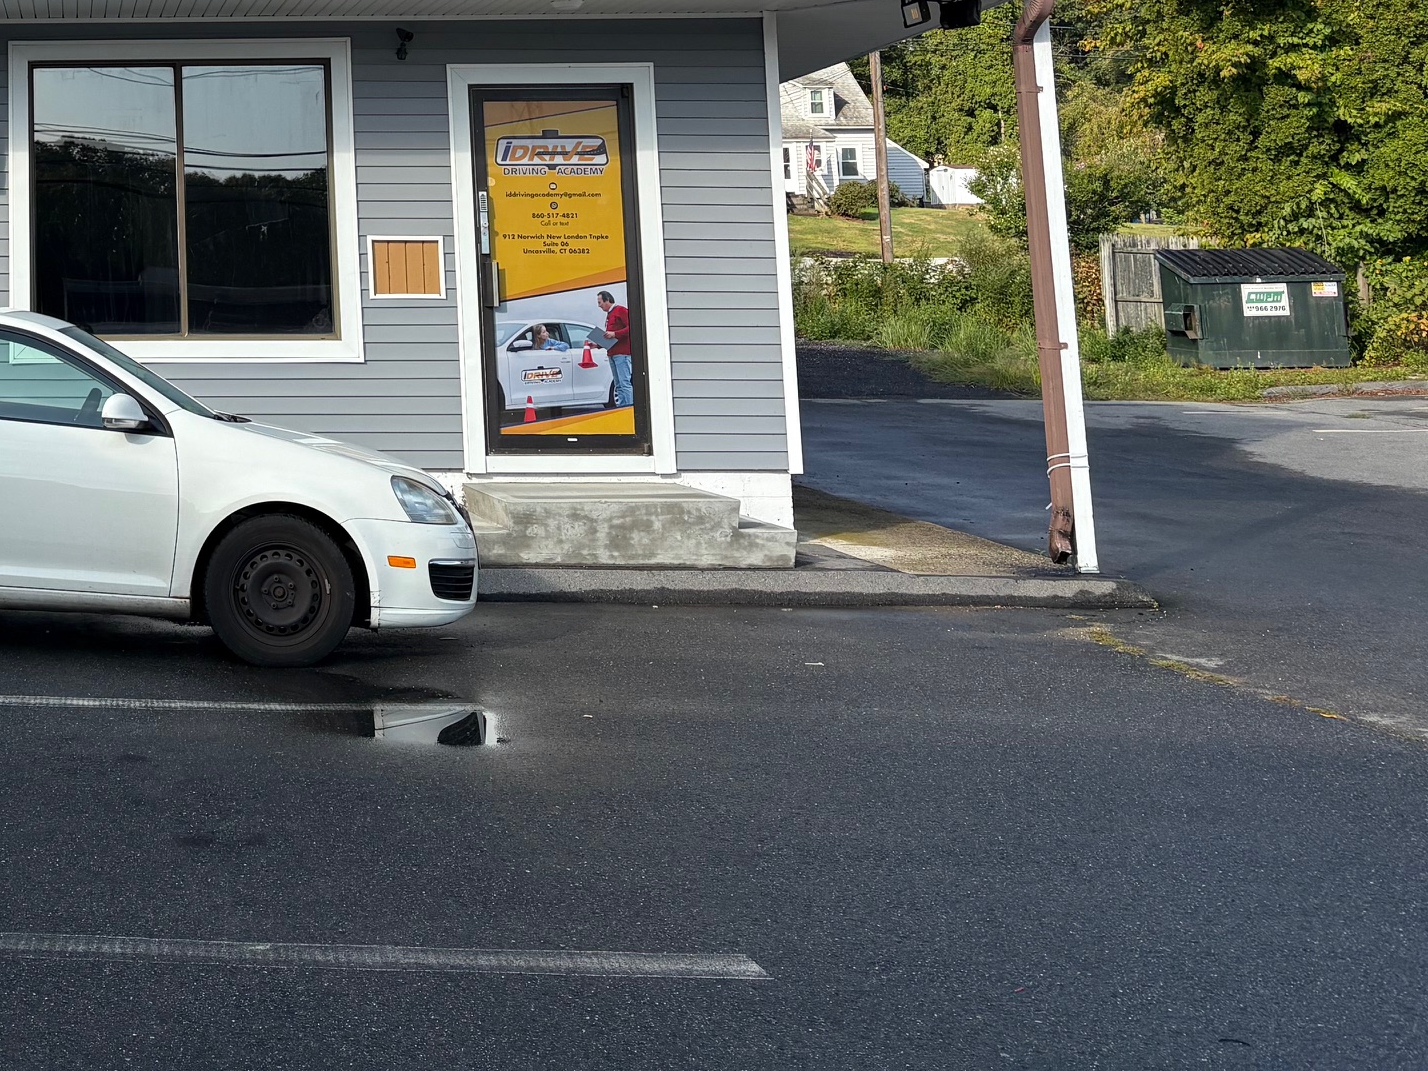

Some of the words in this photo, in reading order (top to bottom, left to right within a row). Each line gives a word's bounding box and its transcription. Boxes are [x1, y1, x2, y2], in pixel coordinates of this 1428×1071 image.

[503, 167, 547, 176] DRIVING
[556, 167, 605, 176] ACADEMY
[505, 191, 602, 199] iddrivingacademy@gmail.com
[589, 233, 609, 241] Tnpke
